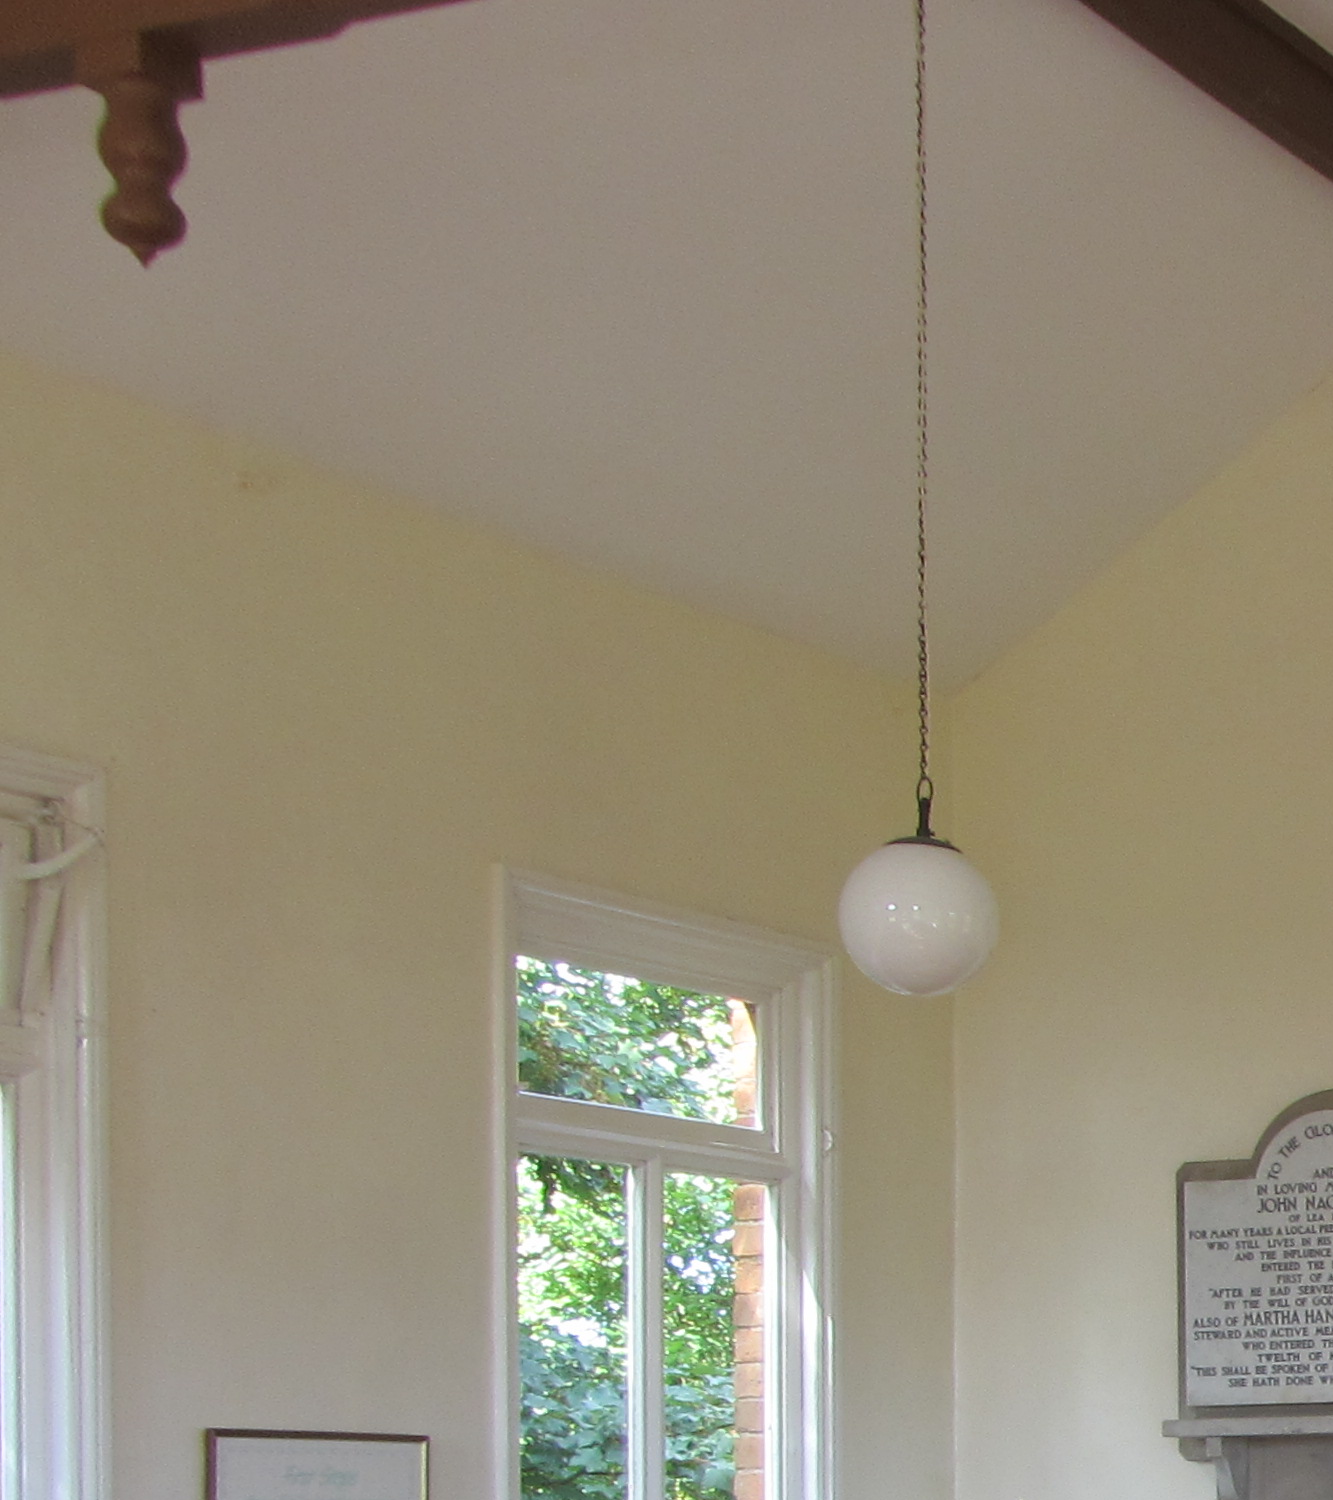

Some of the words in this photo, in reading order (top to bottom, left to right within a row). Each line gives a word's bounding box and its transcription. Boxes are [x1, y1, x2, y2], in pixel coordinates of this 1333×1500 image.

[1267, 1162, 1281, 1180] TO
[1279, 1136, 1300, 1158] THE
[1257, 1184, 1268, 1196] IN
[1274, 1182, 1317, 1195] LOVING
[1256, 1195, 1297, 1213] JOHN
[1288, 1214, 1300, 1223] OF
[1307, 1213, 1325, 1222] LEA
[1189, 1230, 1207, 1240] FOR
[1210, 1228, 1239, 1239] MANY
[1242, 1227, 1273, 1237] YEARS
[1276, 1227, 1284, 1236] A
[1285, 1224, 1317, 1235] LOCAL
[1207, 1241, 1229, 1250] WHO
[1235, 1239, 1260, 1249] STILL
[1267, 1238, 1296, 1249] LIVES
[1301, 1236, 1311, 1247] IN
[1317, 1235, 1332, 1246] HIS
[1234, 1251, 1255, 1261] AND
[1260, 1250, 1276, 1260] THE
[1282, 1248, 1332, 1259] INFLUENCE
[1260, 1261, 1300, 1272] ENTERED
[1307, 1260, 1325, 1270] THE
[1276, 1273, 1303, 1284] FIRST
[1309, 1272, 1323, 1283] OF
[1250, 1287, 1262, 1298] HE
[1269, 1285, 1291, 1297] HAD
[1224, 1300, 1236, 1311] BY
[1242, 1299, 1260, 1310] THE
[1267, 1298, 1291, 1308] WILL
[1295, 1297, 1308, 1308] OF
[1193, 1317, 1221, 1328] ALSO
[1225, 1316, 1239, 1327] OF
[1243, 1310, 1300, 1326] MARTHA
[1193, 1330, 1242, 1341] STEWARD
[1244, 1328, 1268, 1339] AND
[1270, 1326, 1309, 1338] ACTIVE
[1242, 1341, 1266, 1351] WHO
[1269, 1339, 1315, 1350] ENTERED
[1257, 1352, 1300, 1363] TWELTH
[1308, 1351, 1322, 1361] OF
[1221, 1365, 1251, 1376] SHALL
[1255, 1365, 1267, 1375] BE
[1271, 1363, 1311, 1375] SPOKEN
[1314, 1363, 1329, 1373] OF
[1228, 1377, 1248, 1388] SHE
[1252, 1376, 1280, 1387] HATH
[1285, 1375, 1314, 1386] DONE
